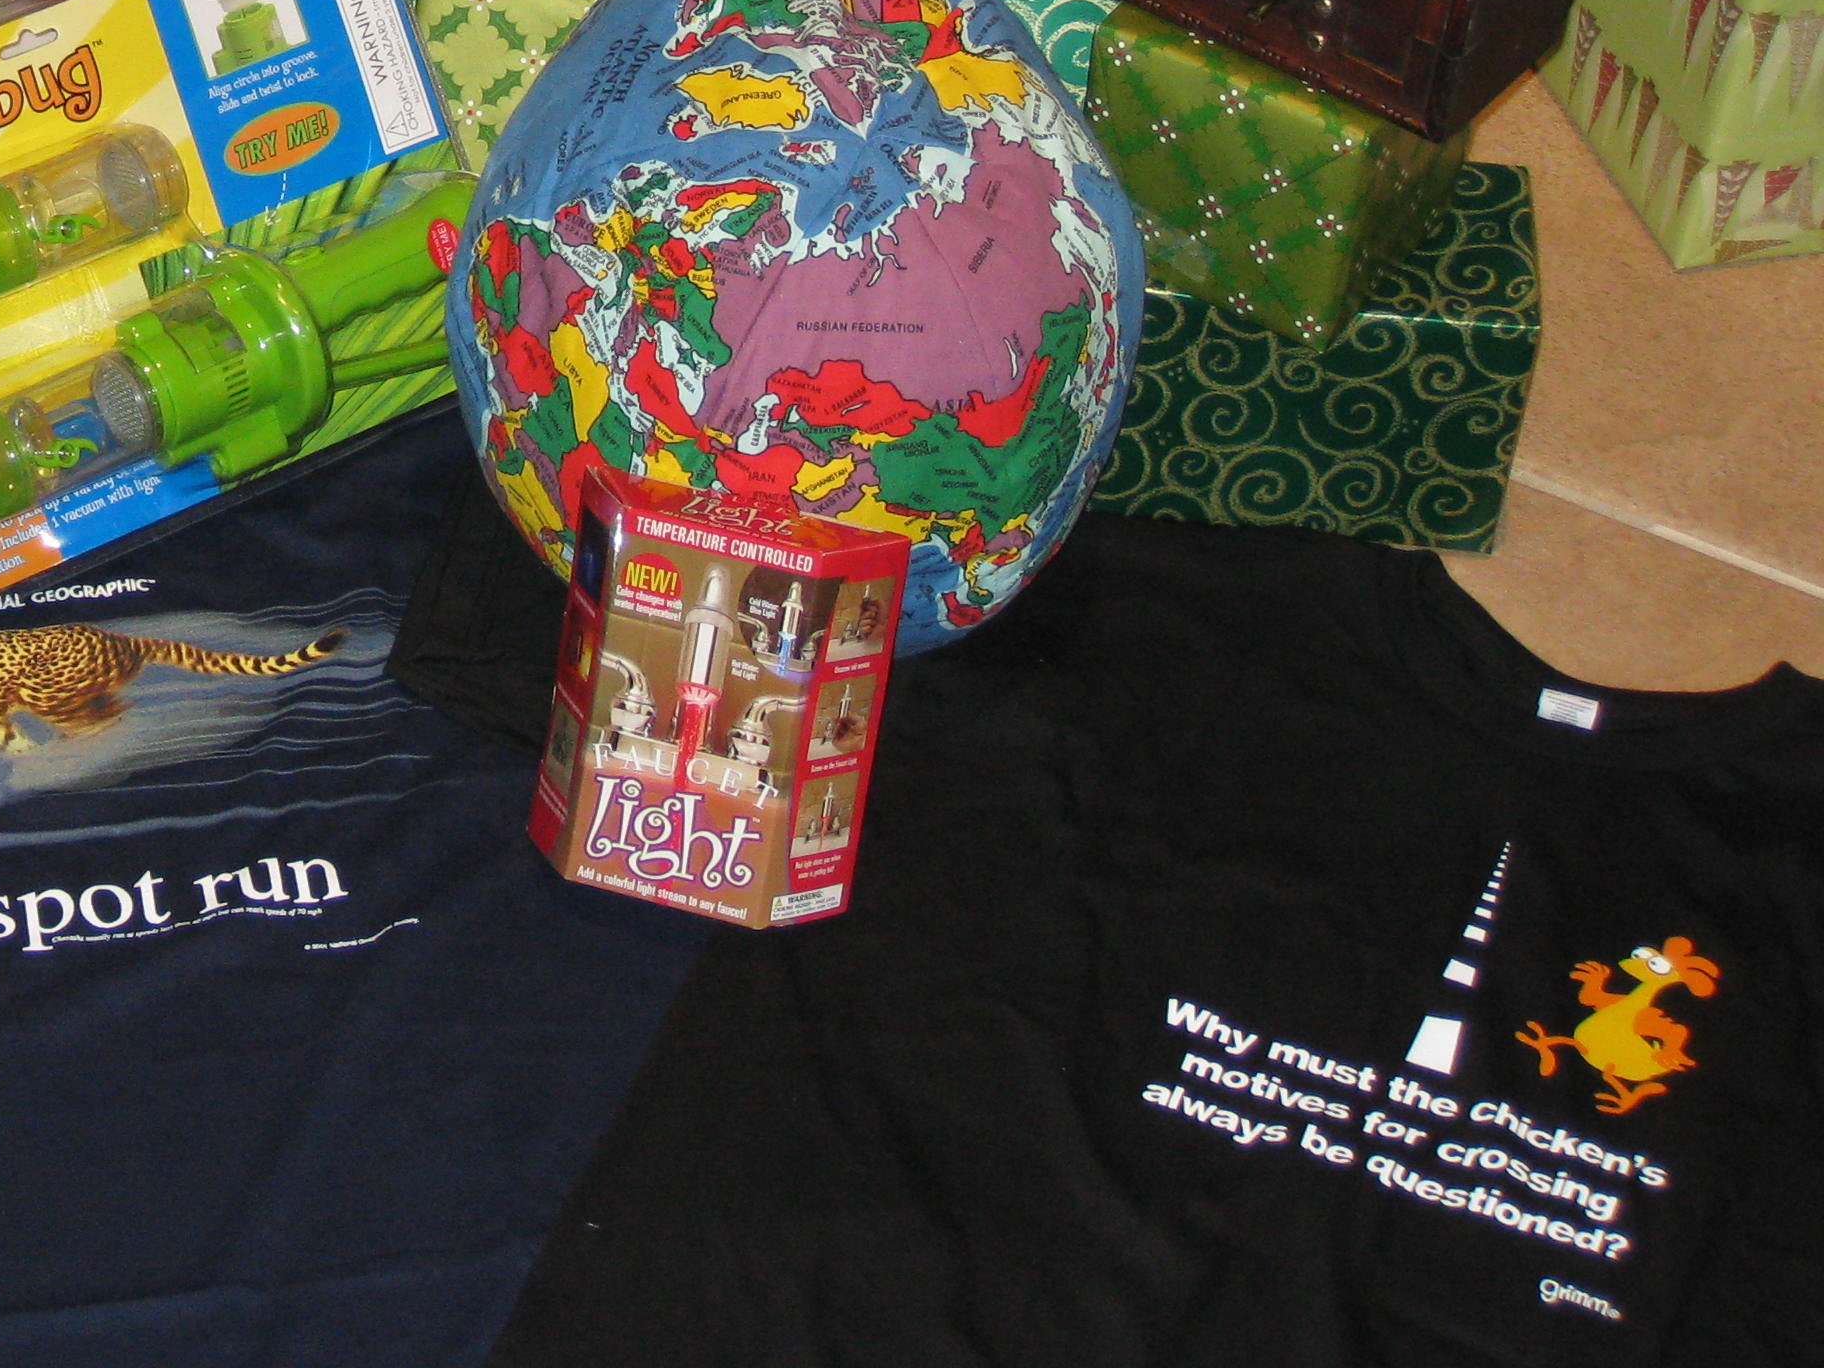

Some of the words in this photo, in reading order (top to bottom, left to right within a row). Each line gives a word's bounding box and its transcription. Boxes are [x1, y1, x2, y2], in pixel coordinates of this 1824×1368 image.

[377, 17, 400, 68] HAZARD
[218, 95, 241, 114] slide
[242, 90, 258, 104] and
[258, 80, 283, 101] twist
[285, 76, 296, 88] to
[393, 71, 419, 131] CHOKING
[720, 89, 782, 110] GREENLAND
[234, 129, 278, 169] TRY
[287, 110, 330, 150] ME!
[687, 187, 726, 202] NORWAY
[693, 197, 728, 223] SWEDEN
[967, 236, 996, 274] SIBERIA
[795, 322, 848, 333] RUSSIAN
[851, 322, 924, 333] FEDERATION
[562, 358, 584, 388] LIBYA
[933, 399, 977, 413] ASIA
[801, 468, 848, 495] AFGHANISTAN
[60, 497, 106, 522] vacuum
[107, 484, 135, 505] with
[680, 495, 801, 536] Light
[636, 516, 728, 553] TEMPERATURE
[730, 539, 814, 573] CONTROLLED
[30, 579, 150, 603] GEOGRAPHIC
[625, 561, 679, 596] NEW!
[592, 743, 778, 810] FAUCET
[586, 776, 760, 889] Light
[192, 856, 351, 917] run
[576, 865, 595, 879] Add
[596, 871, 602, 882] a
[603, 873, 635, 891] colorful
[637, 881, 656, 897] light
[657, 886, 687, 904] stream
[688, 894, 698, 907] to
[700, 898, 716, 912] any
[717, 901, 748, 920] faucet!
[1165, 996, 1260, 1057] Why
[1265, 1040, 1377, 1093] must
[1387, 1074, 1460, 1119] the
[1468, 1098, 1670, 1187] chicken's
[1179, 1052, 1352, 1121] motives
[1361, 1110, 1430, 1147] for
[1436, 1140, 1622, 1223] crossing
[1141, 1081, 1289, 1146] always
[1299, 1123, 1355, 1165] be
[1365, 1154, 1632, 1262] questioned?
[1537, 1276, 1611, 1315] grimm
